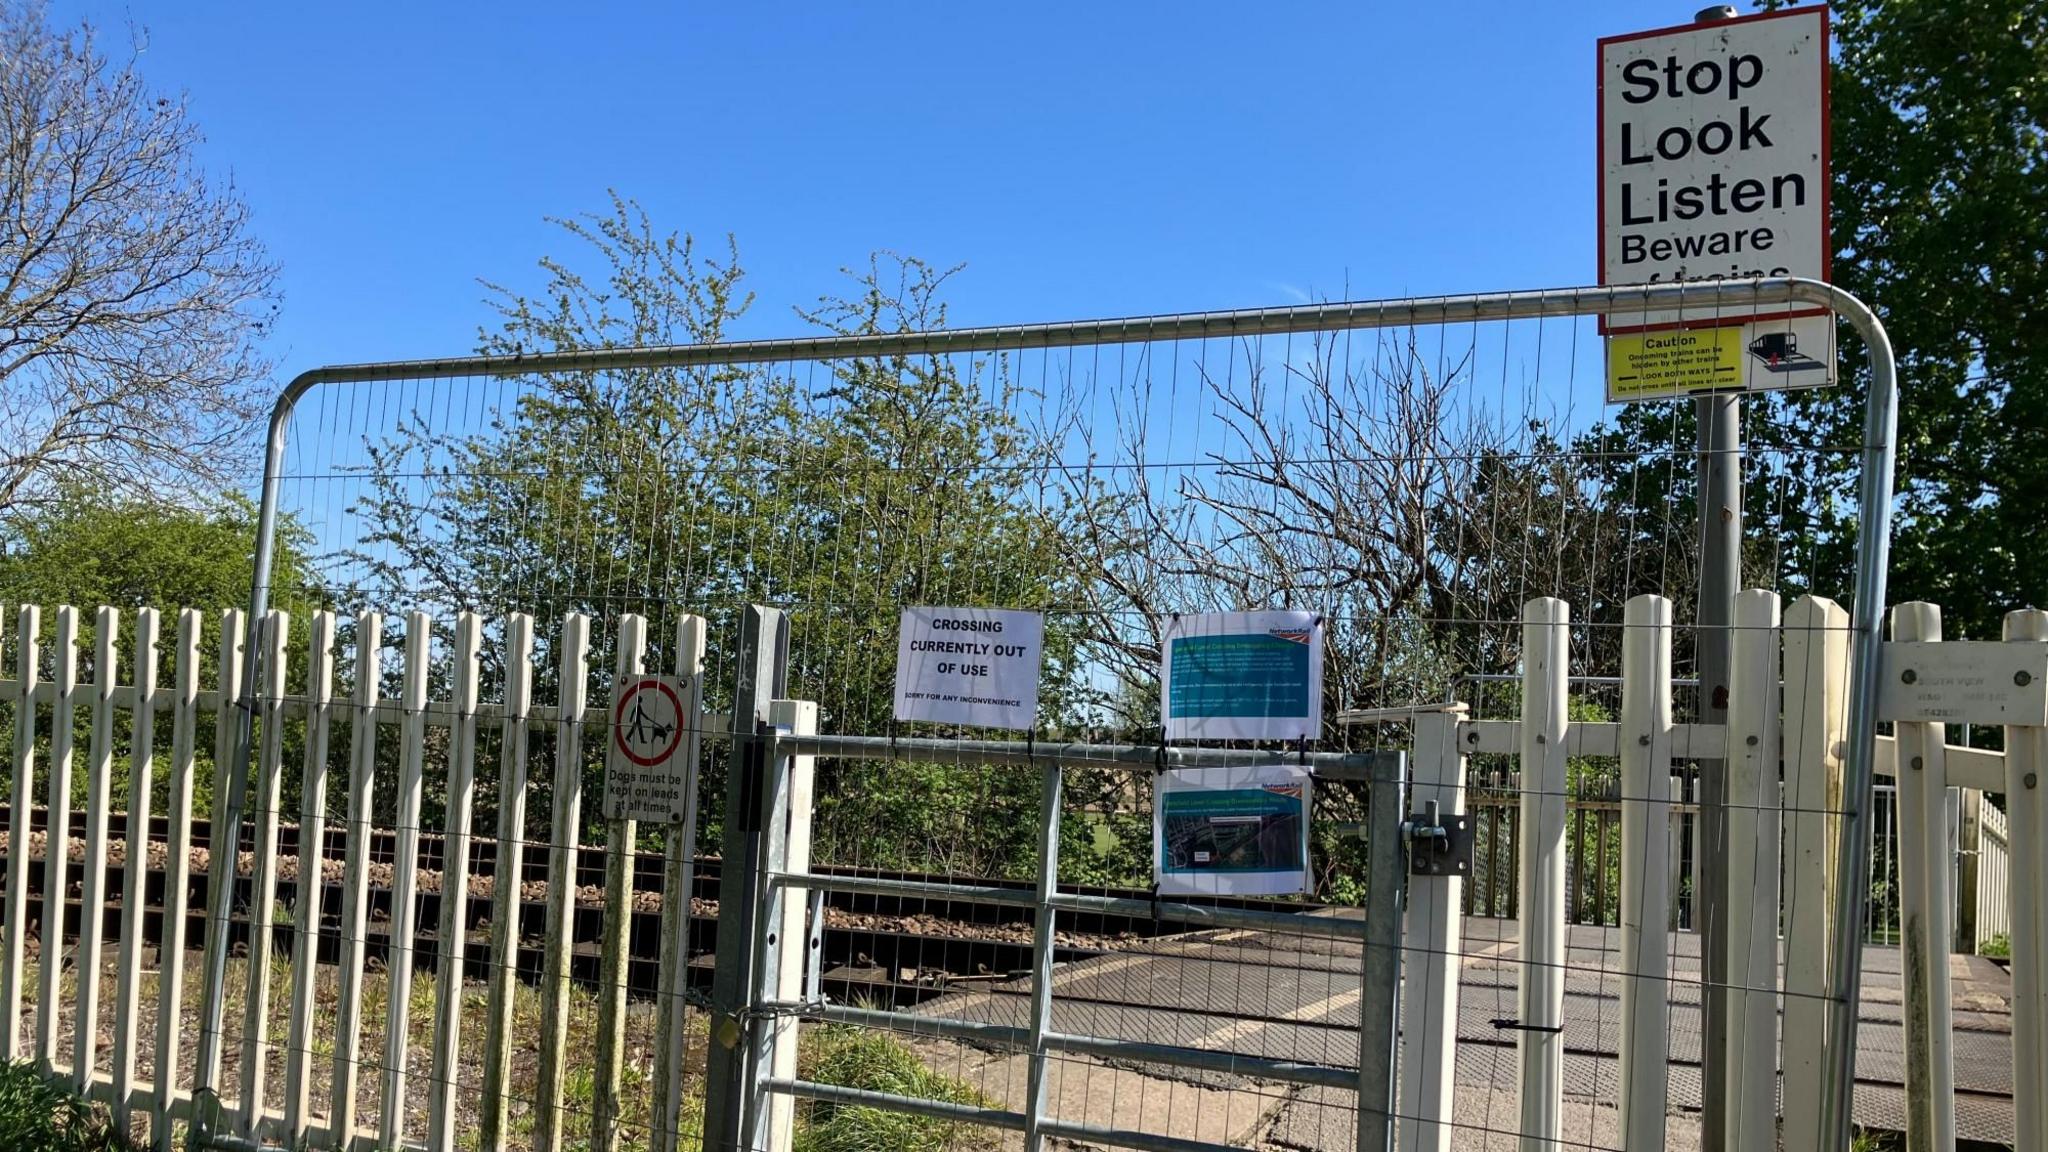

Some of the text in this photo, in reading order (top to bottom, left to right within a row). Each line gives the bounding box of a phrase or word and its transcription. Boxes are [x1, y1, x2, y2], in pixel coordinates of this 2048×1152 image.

[1621, 54, 1763, 104] Stop
[1621, 106, 1774, 165] Look
[1621, 173, 1805, 226] Listen
[1621, 227, 1775, 264] Beware
[1628, 351, 1668, 361] Oncoming
[1670, 349, 1694, 357] trains
[1631, 360, 1658, 370] hidden
[1660, 359, 1670, 368] by
[1687, 367, 1711, 375] WAYS
[932, 618, 1003, 633] CROSSING
[910, 640, 1027, 658] CURRENTLY OUT
[937, 662, 988, 677] OF USE
[904, 691, 1022, 708] SORRY FOR ANY INCONVENIENCE
[609, 769, 681, 785] Dogs must be
[609, 784, 679, 800] kept on leads
[615, 800, 625, 811] at
[628, 800, 641, 812] all
